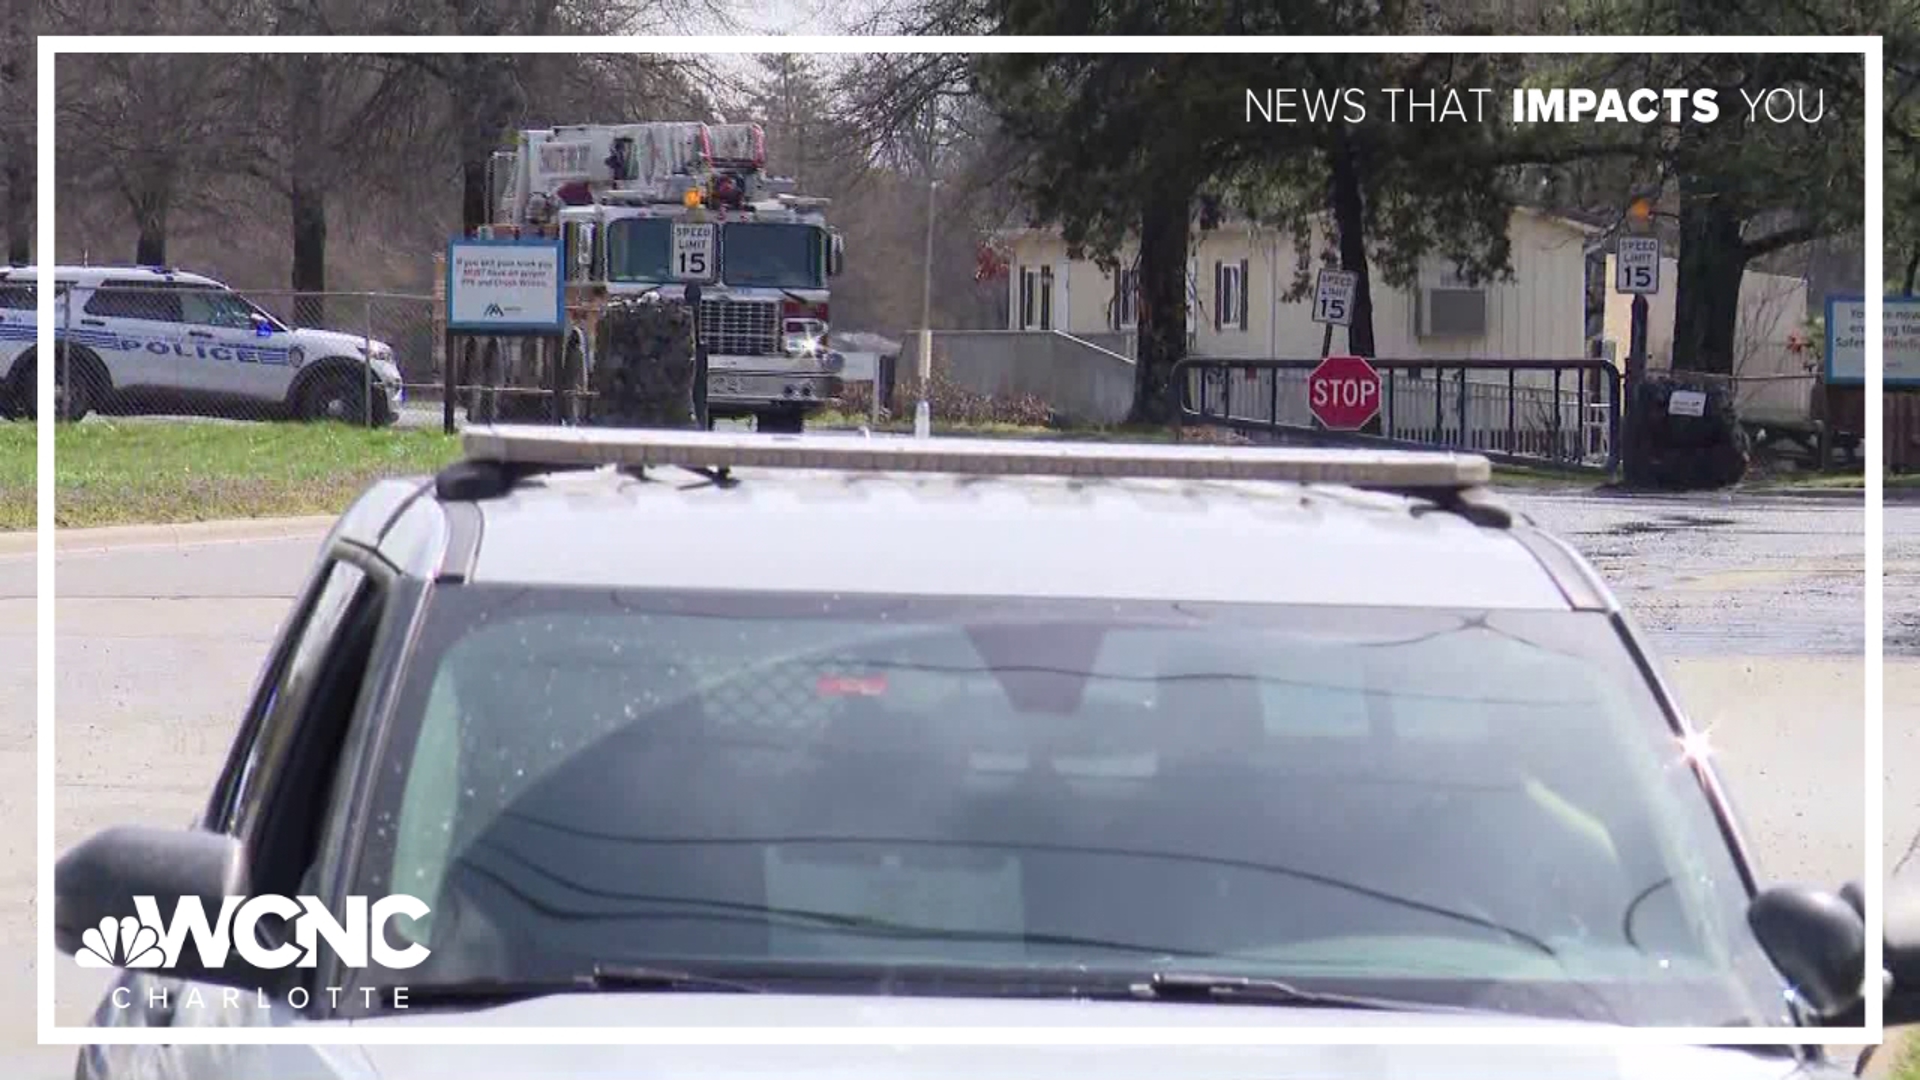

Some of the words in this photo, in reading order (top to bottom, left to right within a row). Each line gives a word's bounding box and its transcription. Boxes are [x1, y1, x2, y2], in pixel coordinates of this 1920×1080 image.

[677, 227, 711, 237] SPEED
[679, 240, 706, 250] LIMIT
[1621, 241, 1656, 251] SPEED
[680, 252, 706, 273] 15
[1624, 253, 1652, 263] LIMIT
[1624, 265, 1651, 287] 15
[1321, 298, 1345, 318] 15
[121, 340, 259, 363] POLICE
[1313, 379, 1375, 407] STOP
